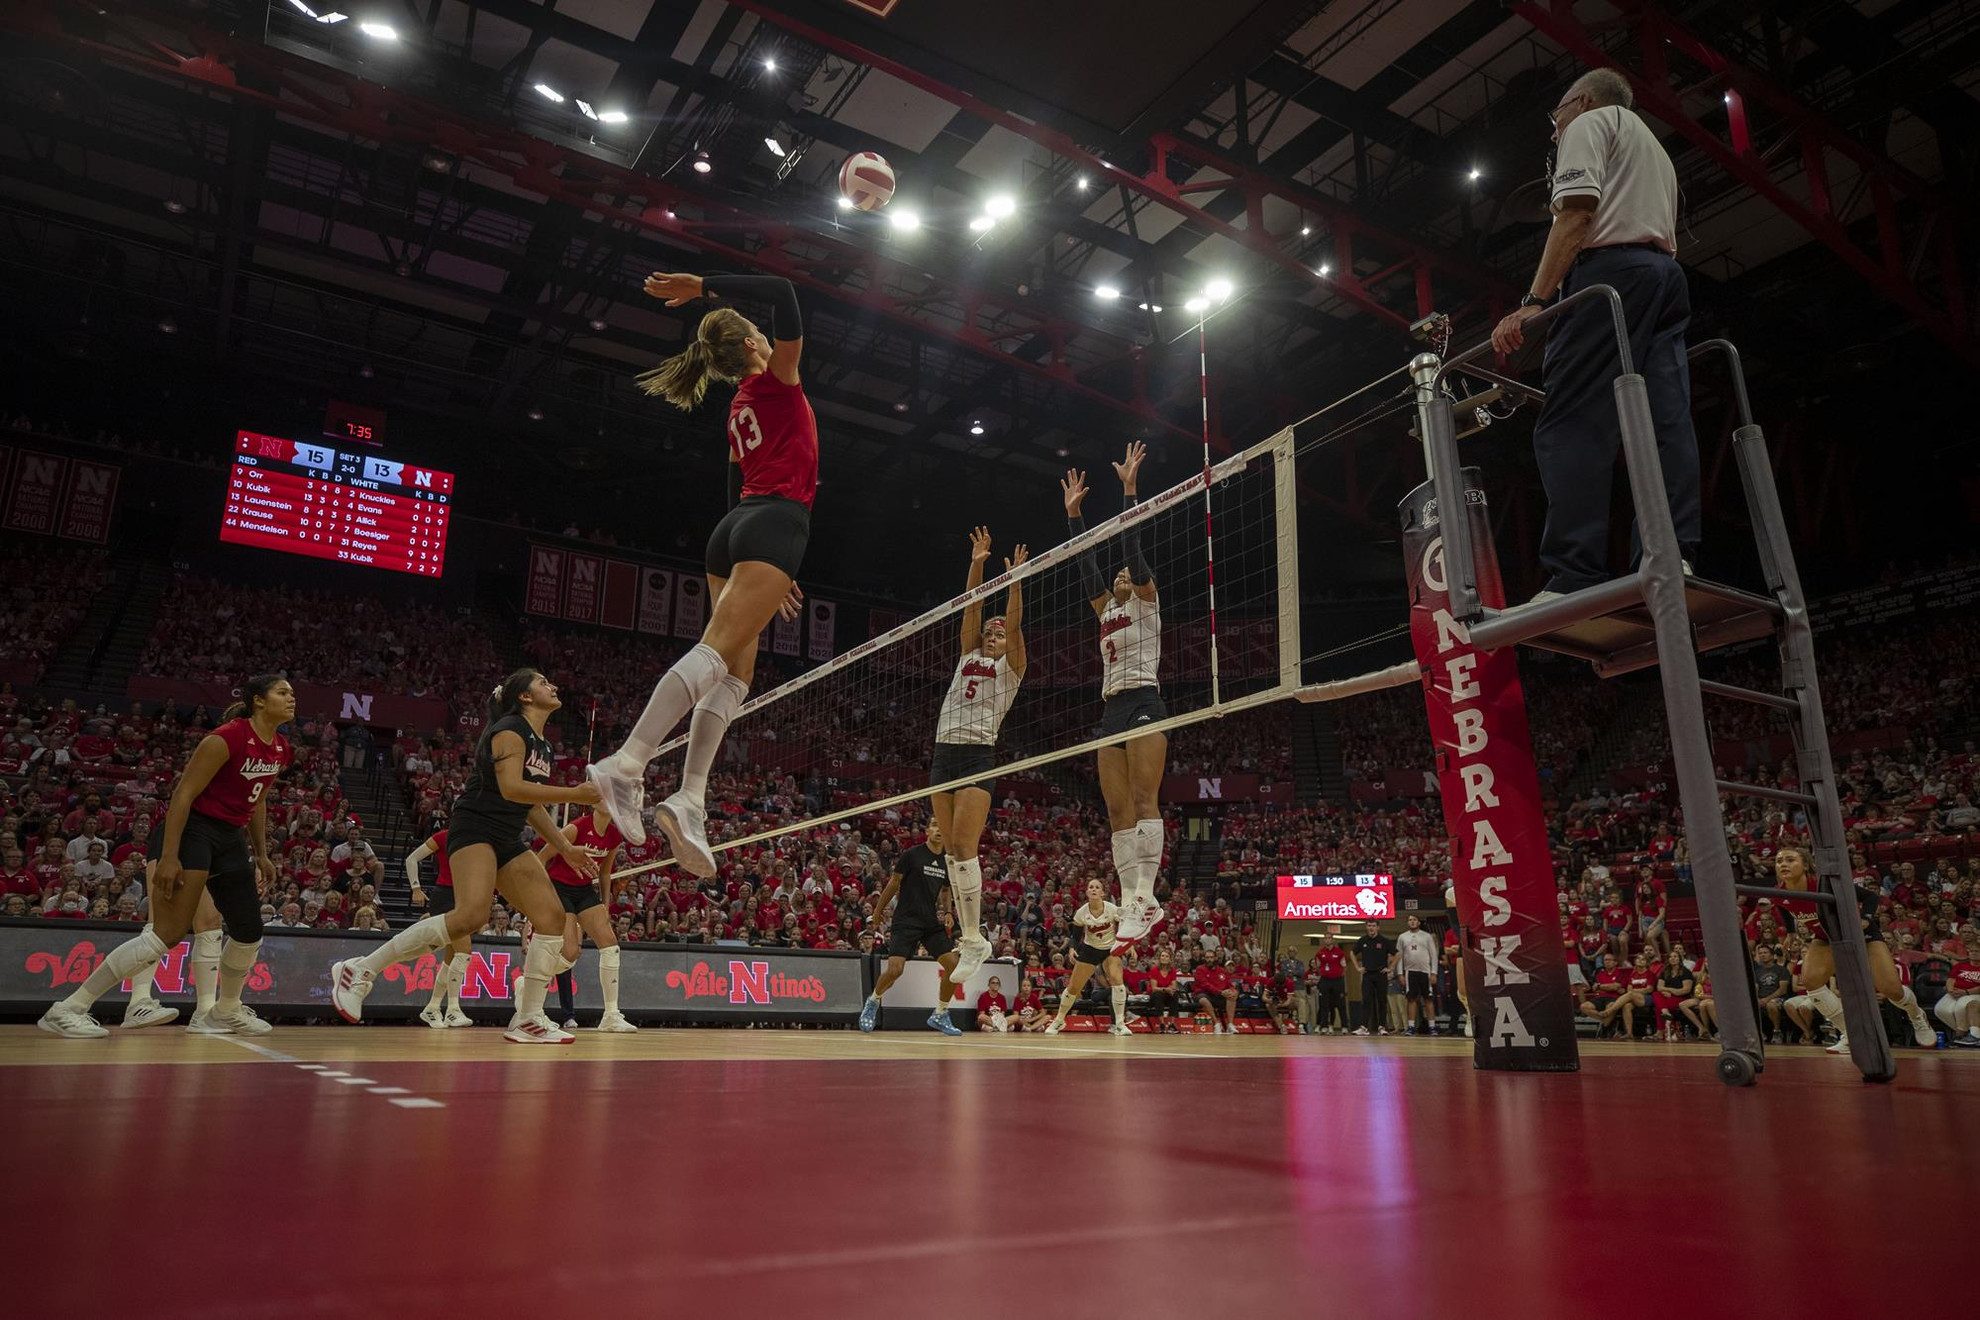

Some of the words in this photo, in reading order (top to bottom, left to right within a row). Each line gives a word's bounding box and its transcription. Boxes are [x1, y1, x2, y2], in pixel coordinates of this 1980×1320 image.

[347, 424, 372, 439] 7:35
[730, 406, 762, 458] 13
[259, 437, 282, 458] N
[308, 449, 324, 464] 15
[340, 453, 354, 462] SET
[22, 456, 58, 485] N
[238, 455, 257, 466] RED
[308, 469, 315, 478] K
[322, 472, 328, 480] B
[341, 464, 356, 474] 2-0
[375, 464, 390, 477] 13
[76, 466, 111, 494] N
[249, 470, 264, 479] Orr
[308, 482, 314, 490] 3
[350, 478, 379, 490] WHITE
[414, 470, 432, 488] N
[234, 480, 242, 488] 10
[246, 483, 270, 494] Kubik
[304, 494, 312, 502] 13
[320, 496, 326, 504] 3
[359, 492, 396, 506] Knuckles
[232, 492, 240, 501] 13
[244, 495, 292, 510] Lauenstein
[304, 506, 310, 514] 8
[358, 504, 382, 514] Evans
[228, 505, 238, 514] 22
[242, 507, 274, 520] Krause
[1118, 502, 1150, 524] HUSKER
[12, 512, 47, 530] 2000
[226, 518, 236, 526] 44
[240, 520, 288, 536] Mendelson
[356, 516, 377, 527] Allick
[67, 522, 100, 538] 2006
[354, 528, 390, 541] Boesiger
[341, 538, 350, 546] 31
[352, 540, 377, 551] Reyes
[338, 550, 348, 558] 33
[350, 552, 374, 564] Kubik
[536, 551, 560, 576] N
[573, 558, 597, 582] N
[974, 572, 1013, 596] VOLLEYBALL
[532, 599, 556, 614] 2015
[569, 606, 592, 618] 2017
[640, 620, 666, 631] 2001
[776, 642, 798, 653] 2018
[1106, 640, 1117, 664] 2
[965, 680, 979, 700] 5
[340, 692, 373, 721] N
[460, 716, 479, 726] C18
[240, 757, 280, 775] Nebrask
[832, 760, 842, 768] C1
[828, 777, 838, 786] B2
[1198, 778, 1222, 798] N
[248, 782, 264, 803] 9
[1433, 608, 1536, 1047] NEBRASKA
[1300, 878, 1308, 886] 15
[1360, 878, 1369, 886] 13
[1379, 876, 1388, 885] N
